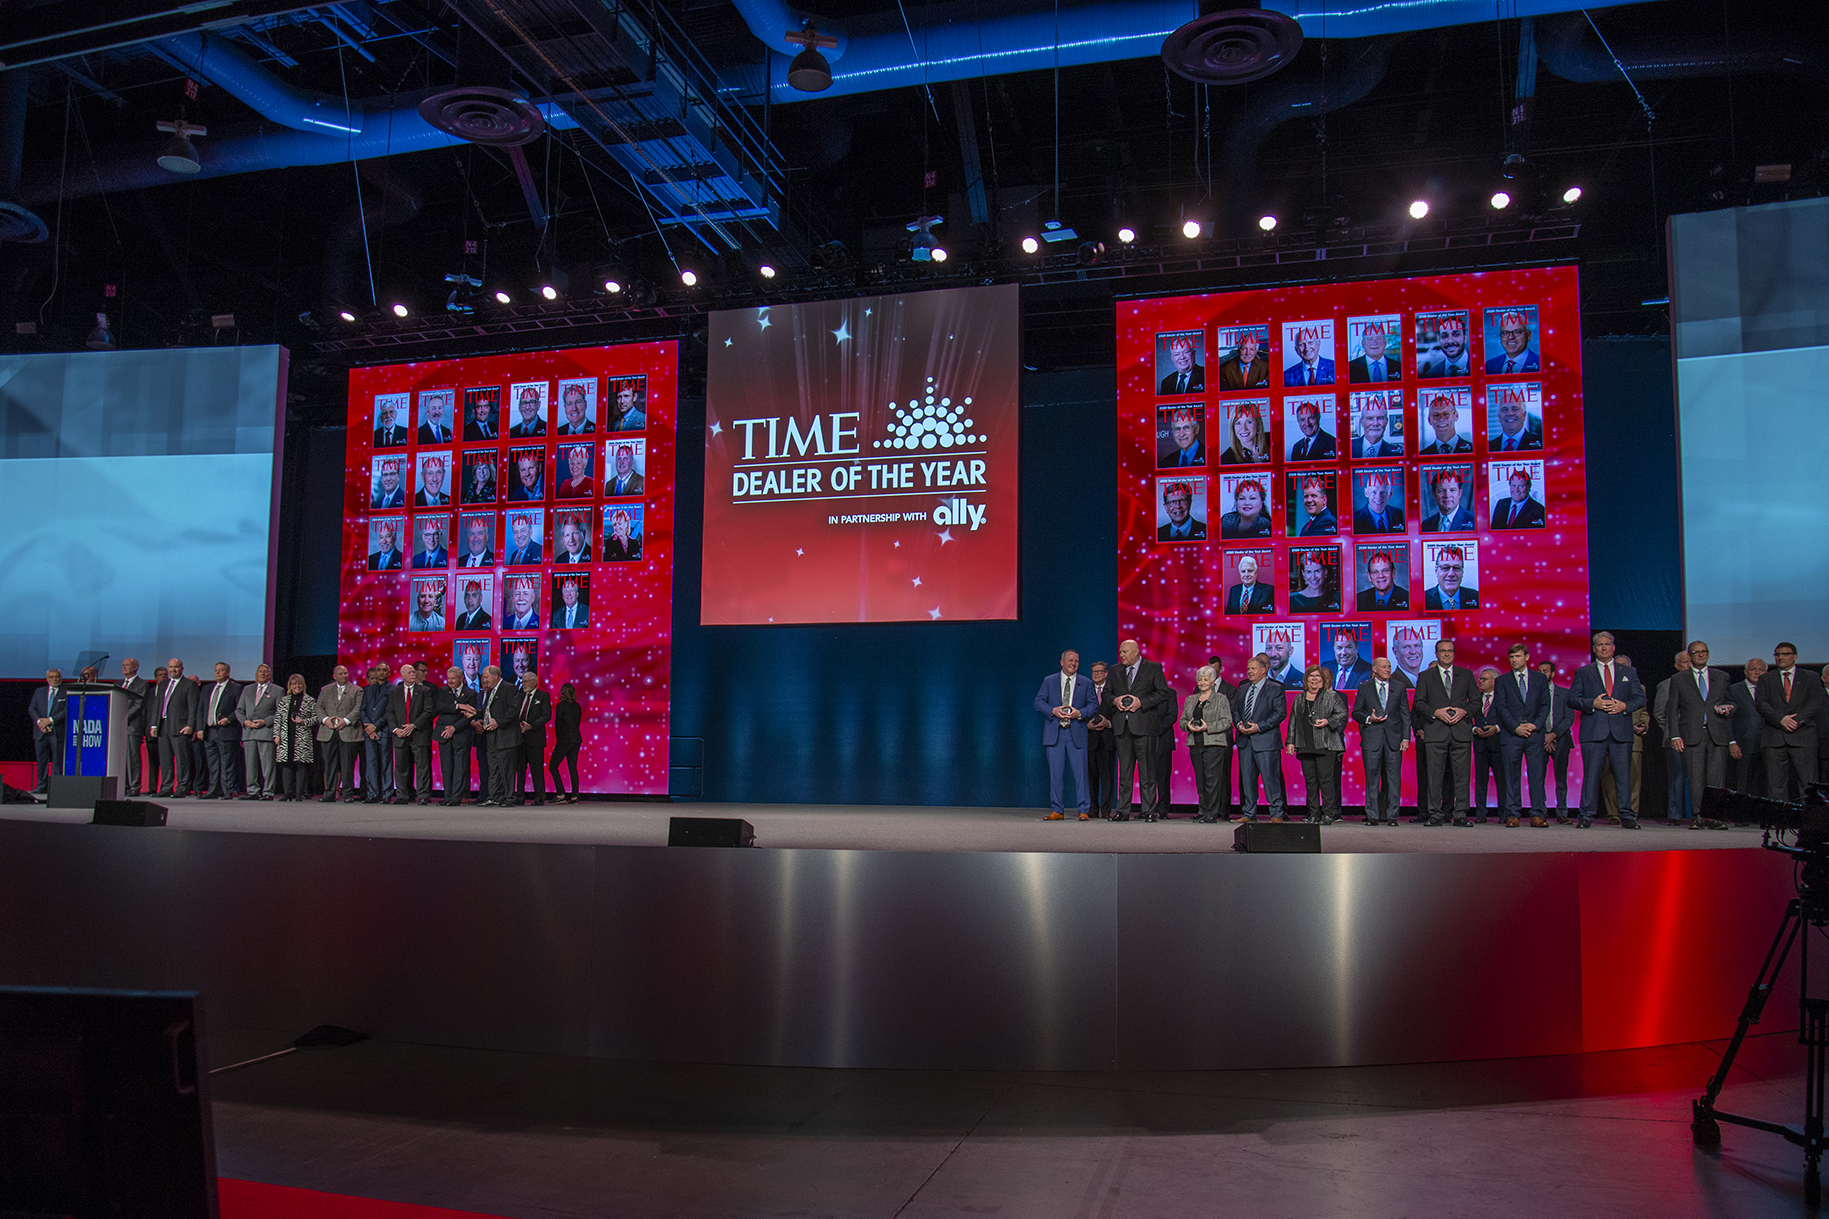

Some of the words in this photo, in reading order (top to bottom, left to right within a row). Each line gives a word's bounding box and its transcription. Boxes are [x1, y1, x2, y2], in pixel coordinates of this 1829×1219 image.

[1419, 315, 1466, 332] TIME
[1487, 310, 1534, 326] TIME
[1286, 325, 1330, 341] TIME
[1351, 320, 1397, 336] TIME
[1158, 334, 1202, 350] TIME
[1222, 330, 1266, 346] TIME
[377, 397, 408, 410] TME
[421, 393, 452, 406] TE
[1421, 391, 1468, 407] TIME
[1490, 388, 1538, 404] TIME
[1222, 403, 1266, 419] TIME
[1288, 399, 1332, 415] TIME
[1159, 408, 1202, 423] TIME
[733, 412, 860, 460] TIME
[733, 468, 822, 496] DEALER
[830, 466, 862, 491] OF
[868, 462, 914, 489] THE
[920, 460, 986, 486] YEAR
[1356, 472, 1402, 487] TIME
[1423, 469, 1470, 484] TIME
[1492, 466, 1540, 481] TIME
[1160, 481, 1203, 496] TIME
[1224, 478, 1268, 492] TIME
[1289, 474, 1334, 490] TIME
[828, 515, 838, 524] IN
[840, 513, 900, 524] PARTNERSHIP
[903, 512, 927, 522] WITH
[1292, 550, 1338, 566] TIME
[1359, 548, 1406, 564] TIME
[1427, 546, 1474, 561] TIME
[1256, 628, 1302, 643] TIME
[1322, 627, 1369, 642] TIME
[1390, 626, 1438, 640] TIME
[72, 720, 102, 734] NADA
[82, 734, 102, 748] HOW
